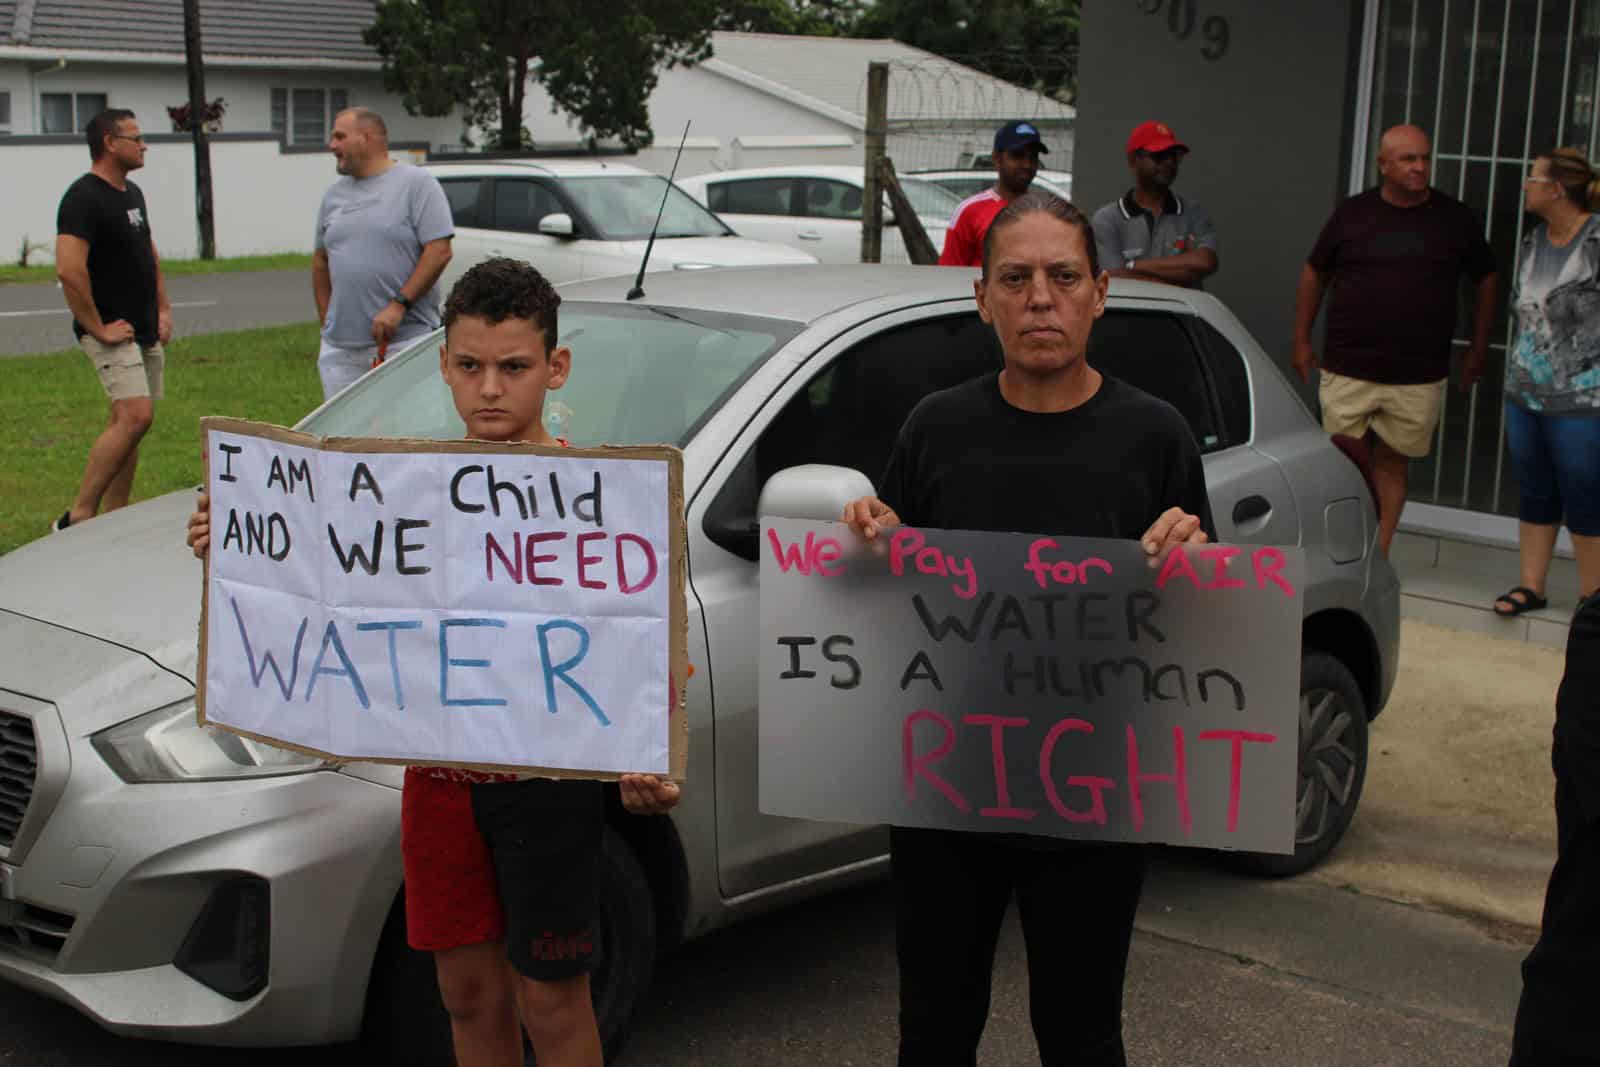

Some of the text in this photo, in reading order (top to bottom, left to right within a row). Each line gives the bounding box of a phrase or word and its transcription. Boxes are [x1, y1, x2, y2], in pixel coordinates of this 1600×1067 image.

[219, 444, 604, 527] I AM A Child
[223, 509, 658, 594] AND WE NEED
[767, 527, 1294, 598] We Pay for AIR
[912, 591, 1166, 642] WATER
[231, 596, 611, 727] WATER
[777, 634, 861, 690] IS
[901, 651, 943, 690] A
[902, 710, 1277, 835] RIGHT
